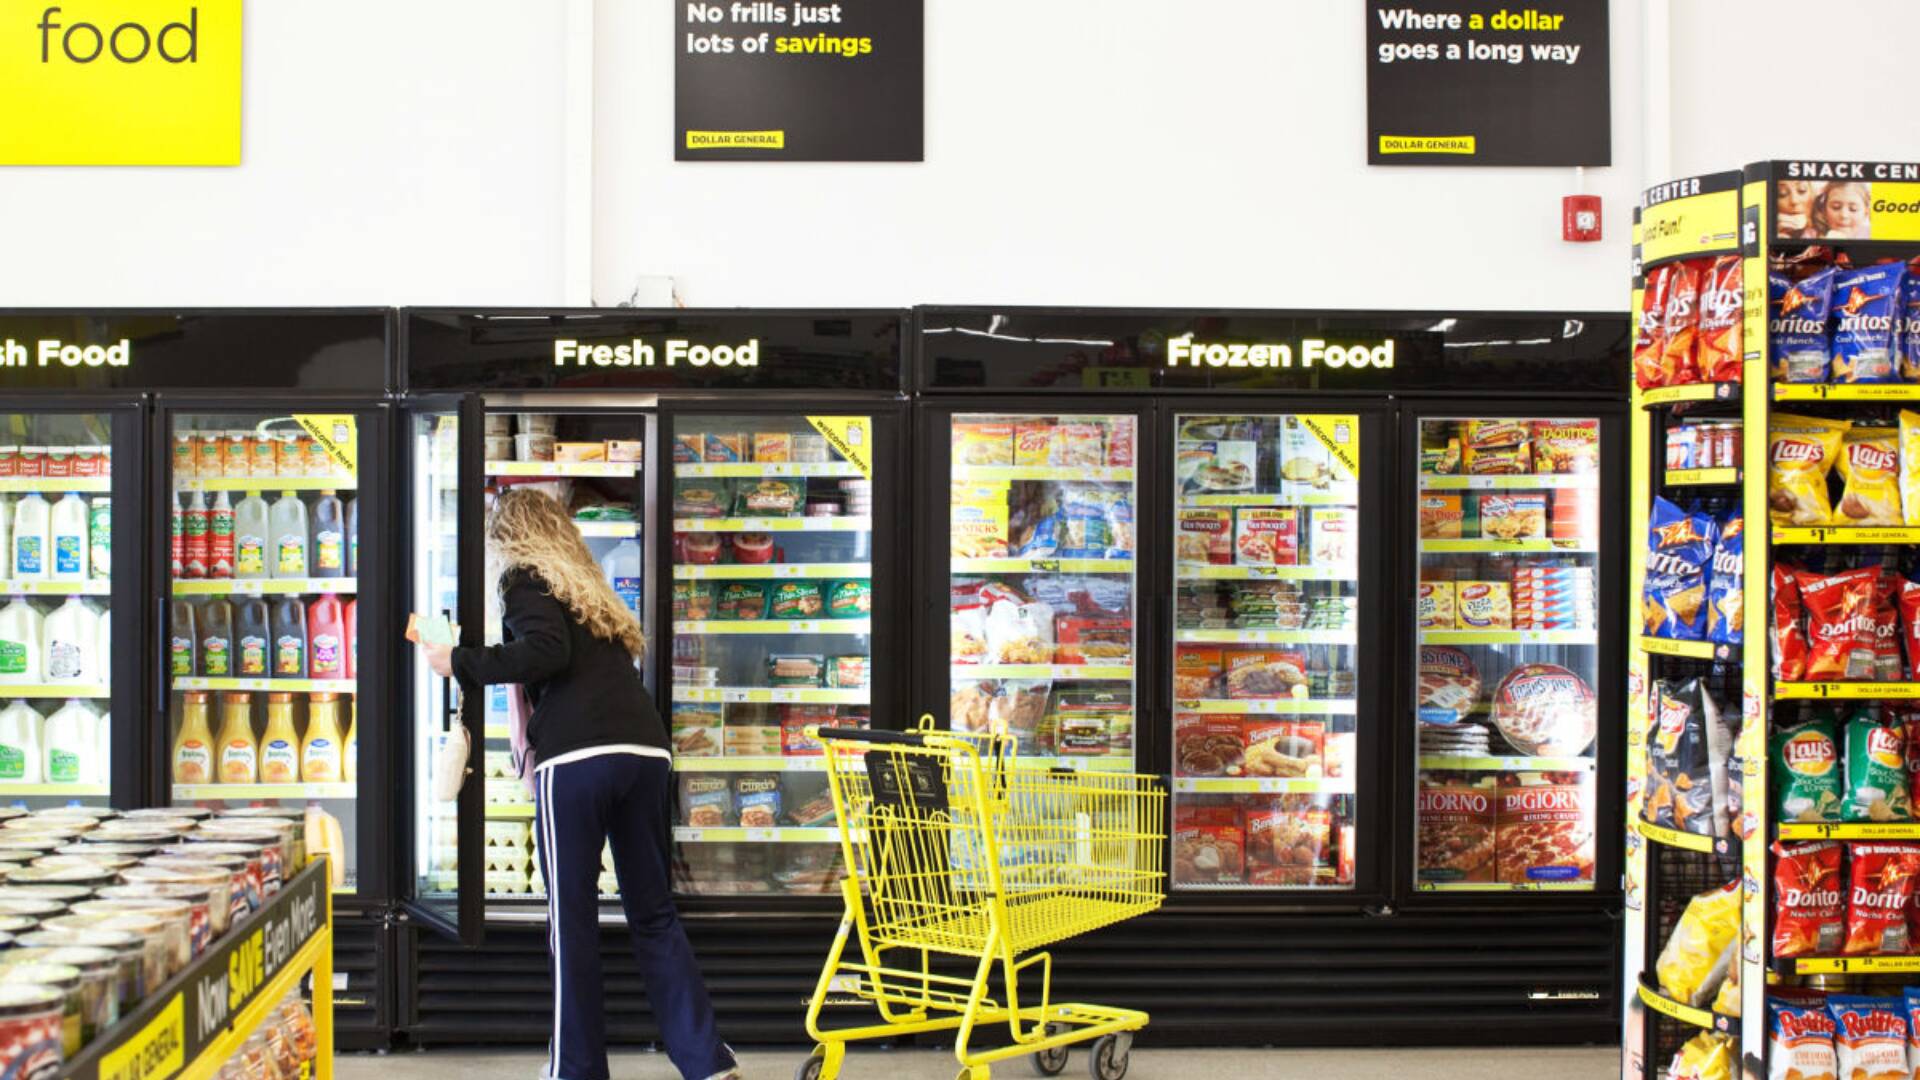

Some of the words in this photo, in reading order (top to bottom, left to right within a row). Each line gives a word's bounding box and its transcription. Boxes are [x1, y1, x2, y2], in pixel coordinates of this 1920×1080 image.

[687, 3, 723, 23] No
[730, 2, 787, 23] frills
[791, 2, 842, 26] just
[1377, 9, 1462, 30] Where
[1468, 14, 1484, 30] a
[1490, 10, 1564, 30] dollar
[37, 7, 198, 63] food
[687, 33, 735, 53] lots
[741, 32, 769, 53] of
[774, 33, 873, 57] savings
[1378, 43, 1439, 63] goes
[1445, 44, 1461, 60] a
[1468, 40, 1524, 64] long
[1530, 44, 1581, 64] way
[691, 135, 731, 144] DOLLAR
[733, 135, 778, 144] GENERAL
[1384, 140, 1424, 149] DOLLAR
[1425, 140, 1470, 149] GENERAL
[1788, 162, 1864, 178] SNACK
[1650, 178, 1701, 205] CENTER
[1873, 199, 1920, 213] Good
[1770, 316, 1825, 334] oritos
[38, 340, 129, 367] Food
[554, 339, 655, 367] Fresh
[665, 339, 759, 367] Food
[1167, 338, 1291, 368] Frozen
[1302, 339, 1395, 368] Food
[303, 418, 337, 451] welcome
[335, 449, 354, 471] here
[816, 419, 851, 454] welcome
[849, 451, 868, 472] here
[1305, 418, 1338, 452] welcome
[1337, 449, 1356, 471] here
[1774, 439, 1824, 462] Lay's
[1851, 442, 1898, 470] Lay's
[1819, 611, 1876, 637] Doritos
[1420, 651, 1465, 666] BSTONE
[1789, 738, 1832, 764] Lay's
[1419, 792, 1488, 813] GIORNO
[1506, 791, 1582, 811] DIGIORN
[1785, 886, 1839, 908] Dorito
[198, 971, 228, 1041] Now
[229, 927, 265, 1011] SAVE
[265, 920, 290, 977] Even
[291, 880, 317, 951] More!
[1778, 1010, 1836, 1038] Ruffle
